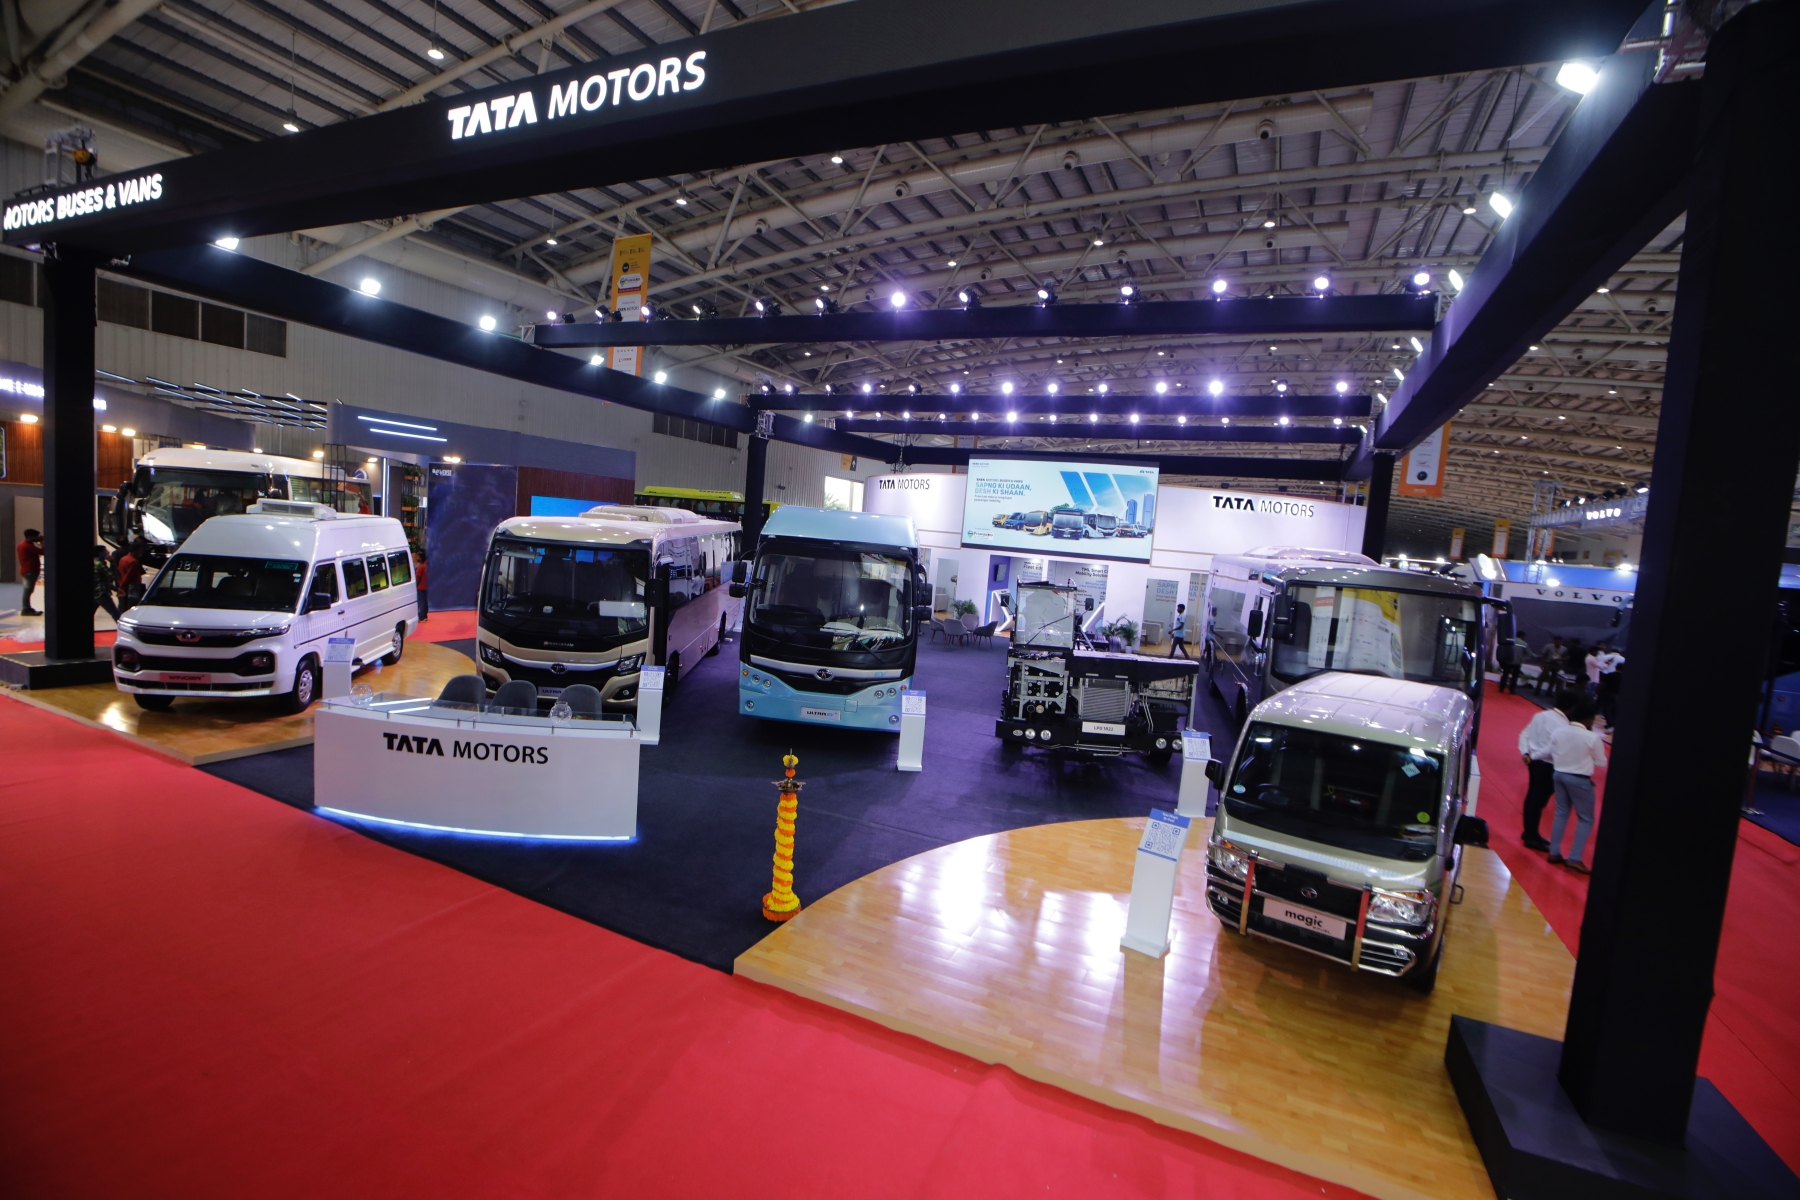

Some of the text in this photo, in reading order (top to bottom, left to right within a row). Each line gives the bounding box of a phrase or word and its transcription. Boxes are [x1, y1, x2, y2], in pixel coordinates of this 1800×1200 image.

[448, 51, 706, 140] TATA MOTORS
[56, 186, 104, 219] BUSES
[105, 184, 116, 209] &
[118, 173, 163, 206] VANS
[879, 479, 930, 490] TATA MOTORS
[1005, 483, 1032, 491] UDAAN,
[1213, 495, 1314, 517] TATA MOTORS
[1586, 508, 1621, 520] VOLVO
[1536, 588, 1622, 603] VOLVO
[383, 732, 549, 765] TATA MOTORS
[1285, 910, 1323, 927] magic
